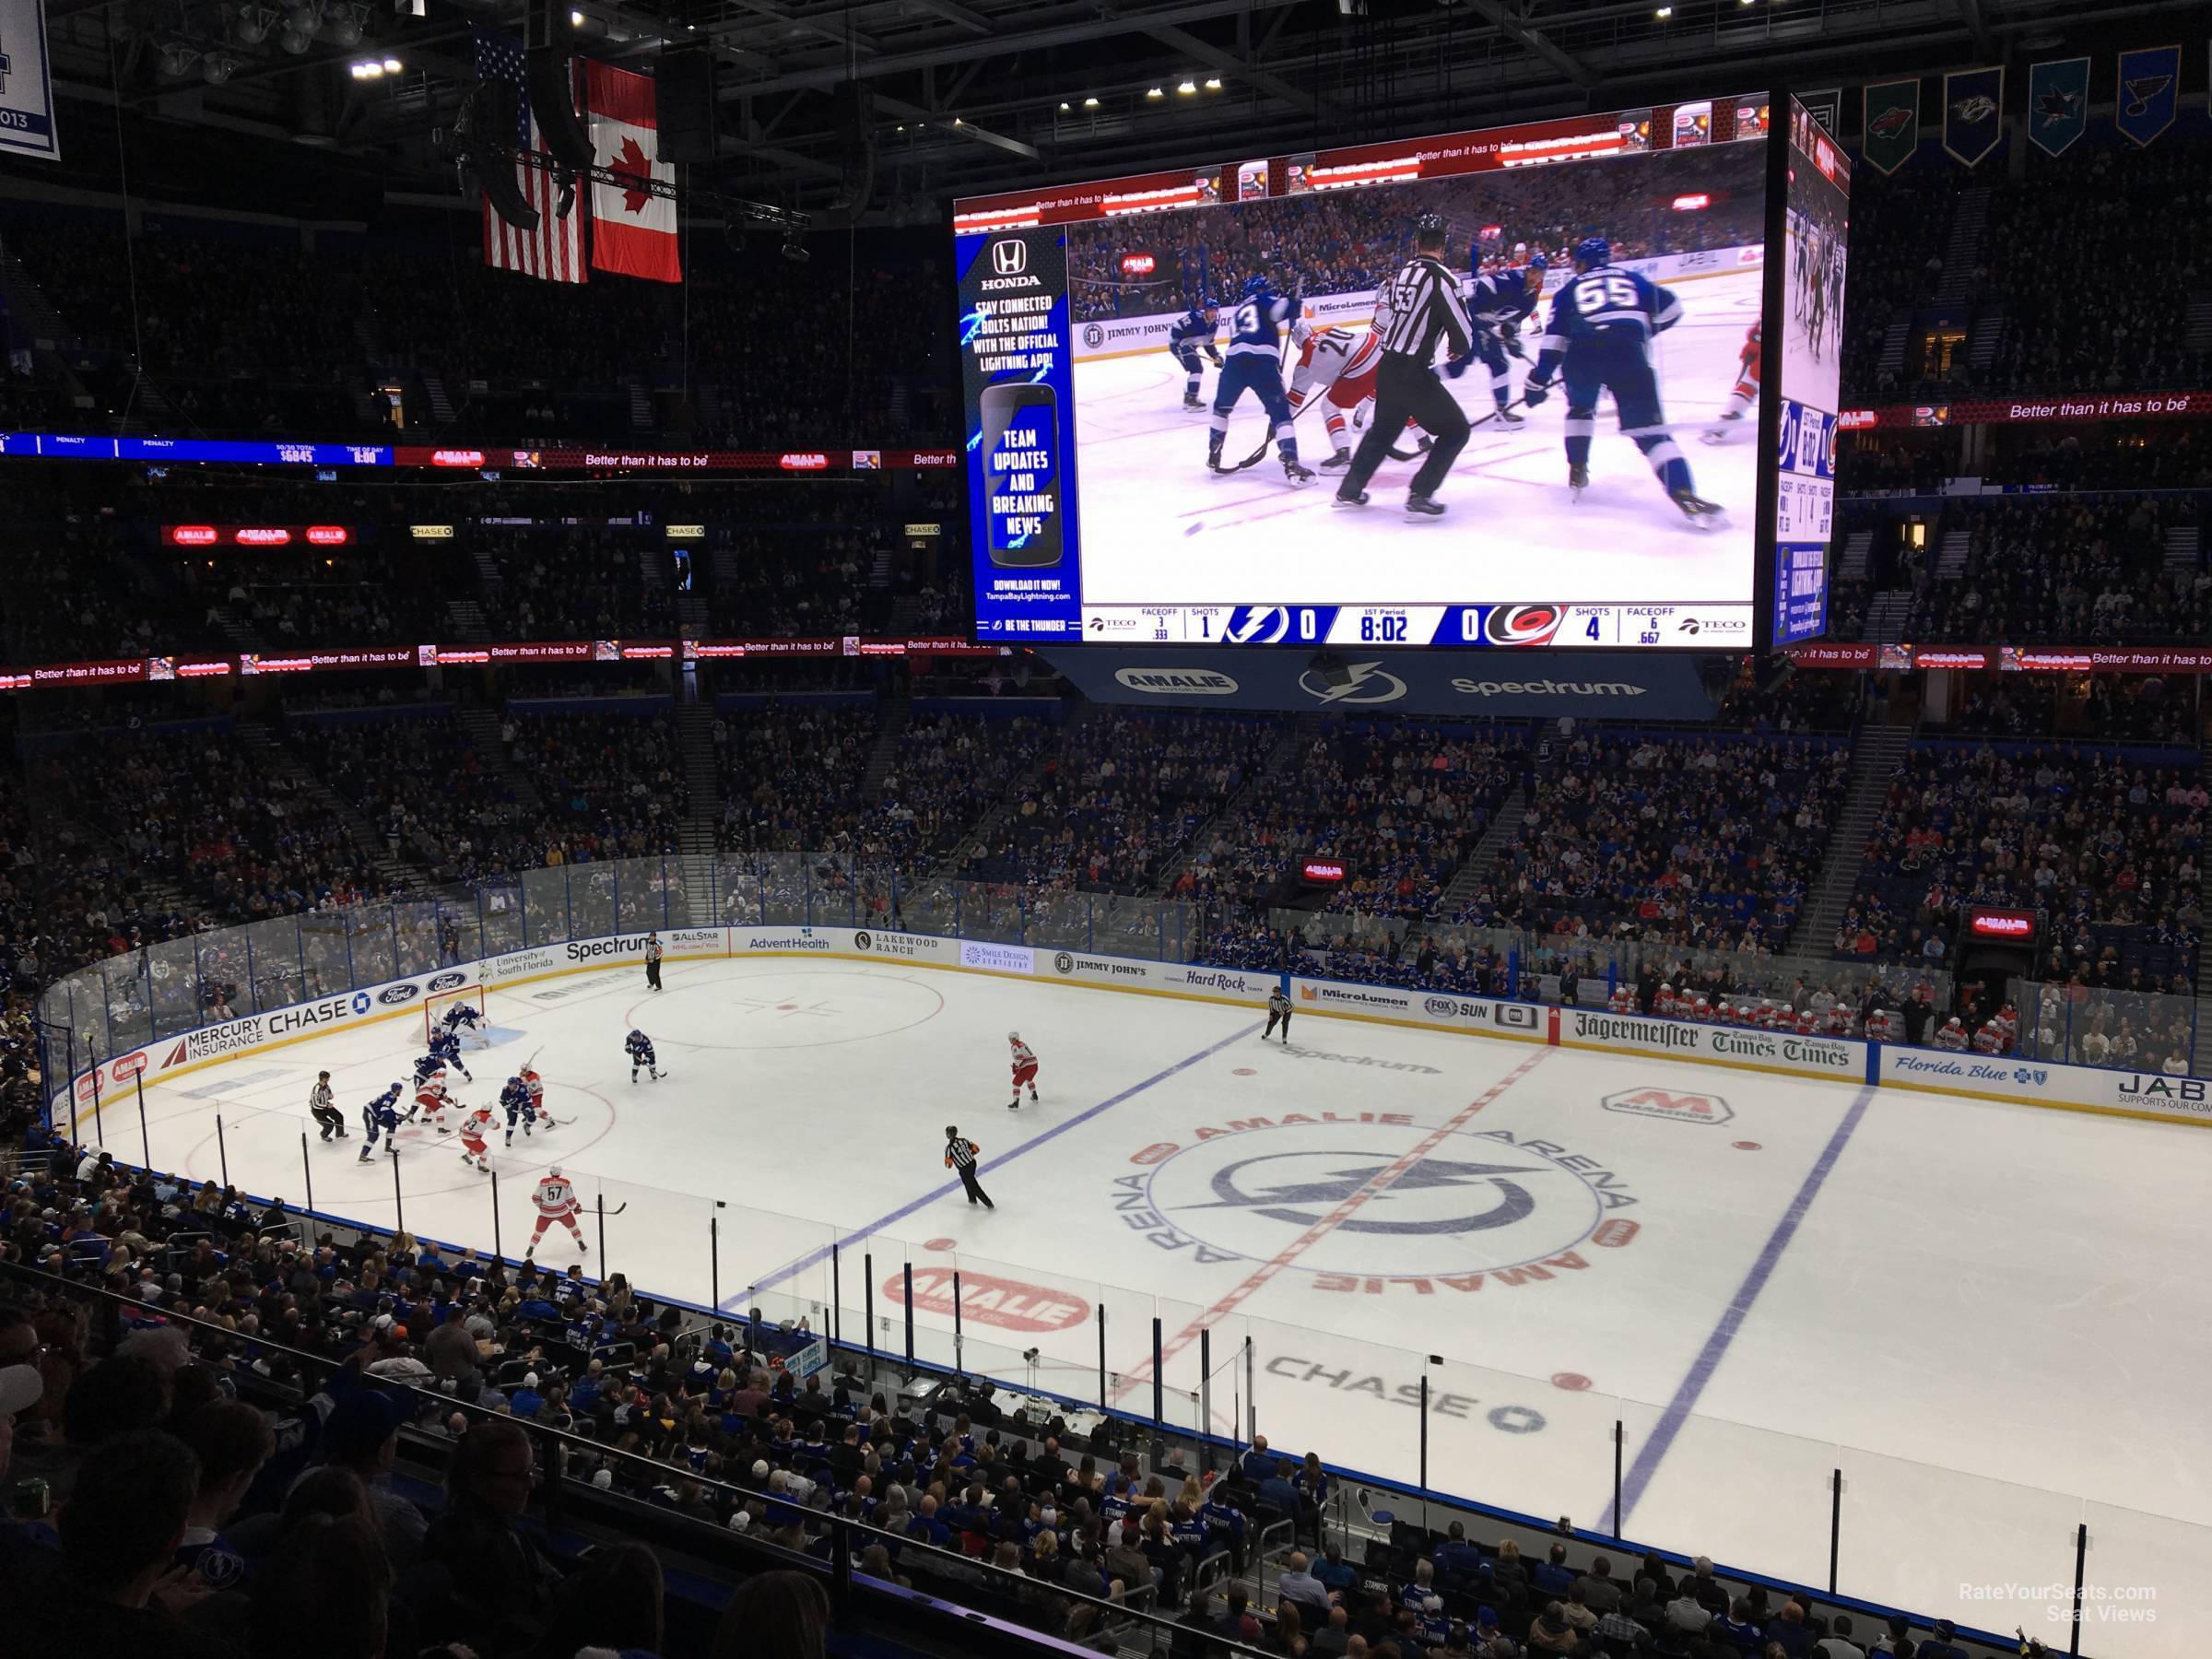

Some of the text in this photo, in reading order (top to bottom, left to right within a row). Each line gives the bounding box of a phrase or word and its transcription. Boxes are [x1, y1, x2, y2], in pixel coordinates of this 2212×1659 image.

[1416, 145, 1499, 161] Better than it has to
[982, 276, 1041, 290] HONDA
[1394, 283, 1419, 312] 53
[1574, 276, 1640, 314] 55
[975, 296, 1053, 315] STAY CONNECTED
[981, 315, 1048, 335] BOLTS NATION!
[1108, 327, 1141, 340] JIMMY
[972, 333, 1059, 354] WITH THE OFFICIAL
[1317, 329, 1356, 358] 20
[980, 352, 1053, 371] LIGHTNING APP!
[2010, 397, 2188, 418] Better than it has to be
[56, 436, 86, 444] PENALTY
[143, 440, 174, 448] PENALTY
[1004, 429, 1036, 448] TEAM
[281, 450, 312, 463] $6845
[585, 453, 708, 467] Better than it has to be
[994, 451, 1048, 471] UPDATES
[1009, 473, 1035, 492] AND
[992, 494, 1054, 514] BREAKING
[412, 526, 443, 536] CHASE
[666, 526, 697, 535] CHASE
[905, 525, 933, 535] CHASE
[1006, 516, 1041, 535] NEWS
[994, 579, 1061, 592] DOWNLOAD IT NOW!
[986, 592, 1071, 602] TampaBayLightning.com
[1575, 607, 1610, 617] SHOTS
[1627, 607, 1675, 617] FACEOFF
[1005, 619, 1066, 631] BE THE THUNDER
[1159, 617, 1164, 628] 3
[1201, 616, 1210, 639] 1
[1300, 608, 1316, 640] 0
[1360, 616, 1407, 641] 8:02
[1462, 608, 1479, 641] 0
[1585, 616, 1600, 641] 4
[1650, 617, 1658, 629] 6
[1702, 620, 1746, 629] TECO
[1637, 631, 1660, 644] .667
[491, 646, 517, 657] Better
[519, 645, 538, 656] than
[540, 646, 546, 656] it
[547, 645, 565, 656] has
[566, 646, 575, 655] to
[576, 644, 588, 655] be
[745, 641, 770, 652] Better
[771, 641, 789, 652] than
[790, 641, 795, 652] it
[796, 641, 812, 651] has
[813, 641, 822, 651] to
[823, 641, 834, 651] be
[2093, 653, 2129, 665] Better
[2132, 654, 2159, 666] than
[2160, 654, 2171, 665] it
[2172, 654, 2197, 666] has
[2197, 655, 2212, 666] to
[34, 663, 140, 679] Better than it has to be
[1127, 675, 1231, 688] AMALIE
[1451, 677, 1631, 697] Spectrum
[749, 937, 830, 950] AdventHealth
[876, 934, 938, 948] LAKEWOOD
[876, 944, 914, 955] RANCH
[497, 952, 539, 967] University
[981, 947, 1030, 961] SMILE DESIGN
[498, 959, 553, 977] South Florida
[981, 958, 1029, 969] DENTISTRY
[1076, 960, 1147, 977] JIMMY JOHN'S
[435, 975, 461, 992] Ford
[1186, 971, 1245, 993] Hard Rock
[385, 986, 413, 1005] Ford
[1322, 989, 1408, 1006] MicroLumen
[269, 999, 347, 1035] CHASE
[1431, 999, 1451, 1010] FOX
[1460, 1003, 1488, 1018] SUN
[188, 1017, 262, 1047] MERCURY
[1733, 1030, 1773, 1042] Tampa Bay
[189, 1030, 265, 1060] INSURANCE
[1712, 1030, 1776, 1057] Times
[1804, 1039, 1846, 1052] Tampa Bay
[1279, 1046, 1425, 1074] Spectrum
[1783, 1039, 1850, 1066] Times
[1896, 1056, 2007, 1081] Florida Blue
[2118, 1075, 2206, 1101] JAB
[2118, 1094, 2167, 1108] SUPPORTS
[2168, 1097, 2190, 1110] OUR
[1617, 1101, 1714, 1121] MARATHON
[1194, 1111, 1416, 1140] AMALIE
[1477, 1129, 1639, 1210] ARENA
[547, 1185, 563, 1202] 57
[1112, 1171, 1242, 1264] ARENA
[1310, 1250, 1591, 1294] AMALIE
[896, 1275, 1080, 1325] AMALIE
[980, 1312, 1006, 1324] OIL
[1265, 1355, 1480, 1419] CHASE
[1363, 1578, 1389, 1593] STAMKOS
